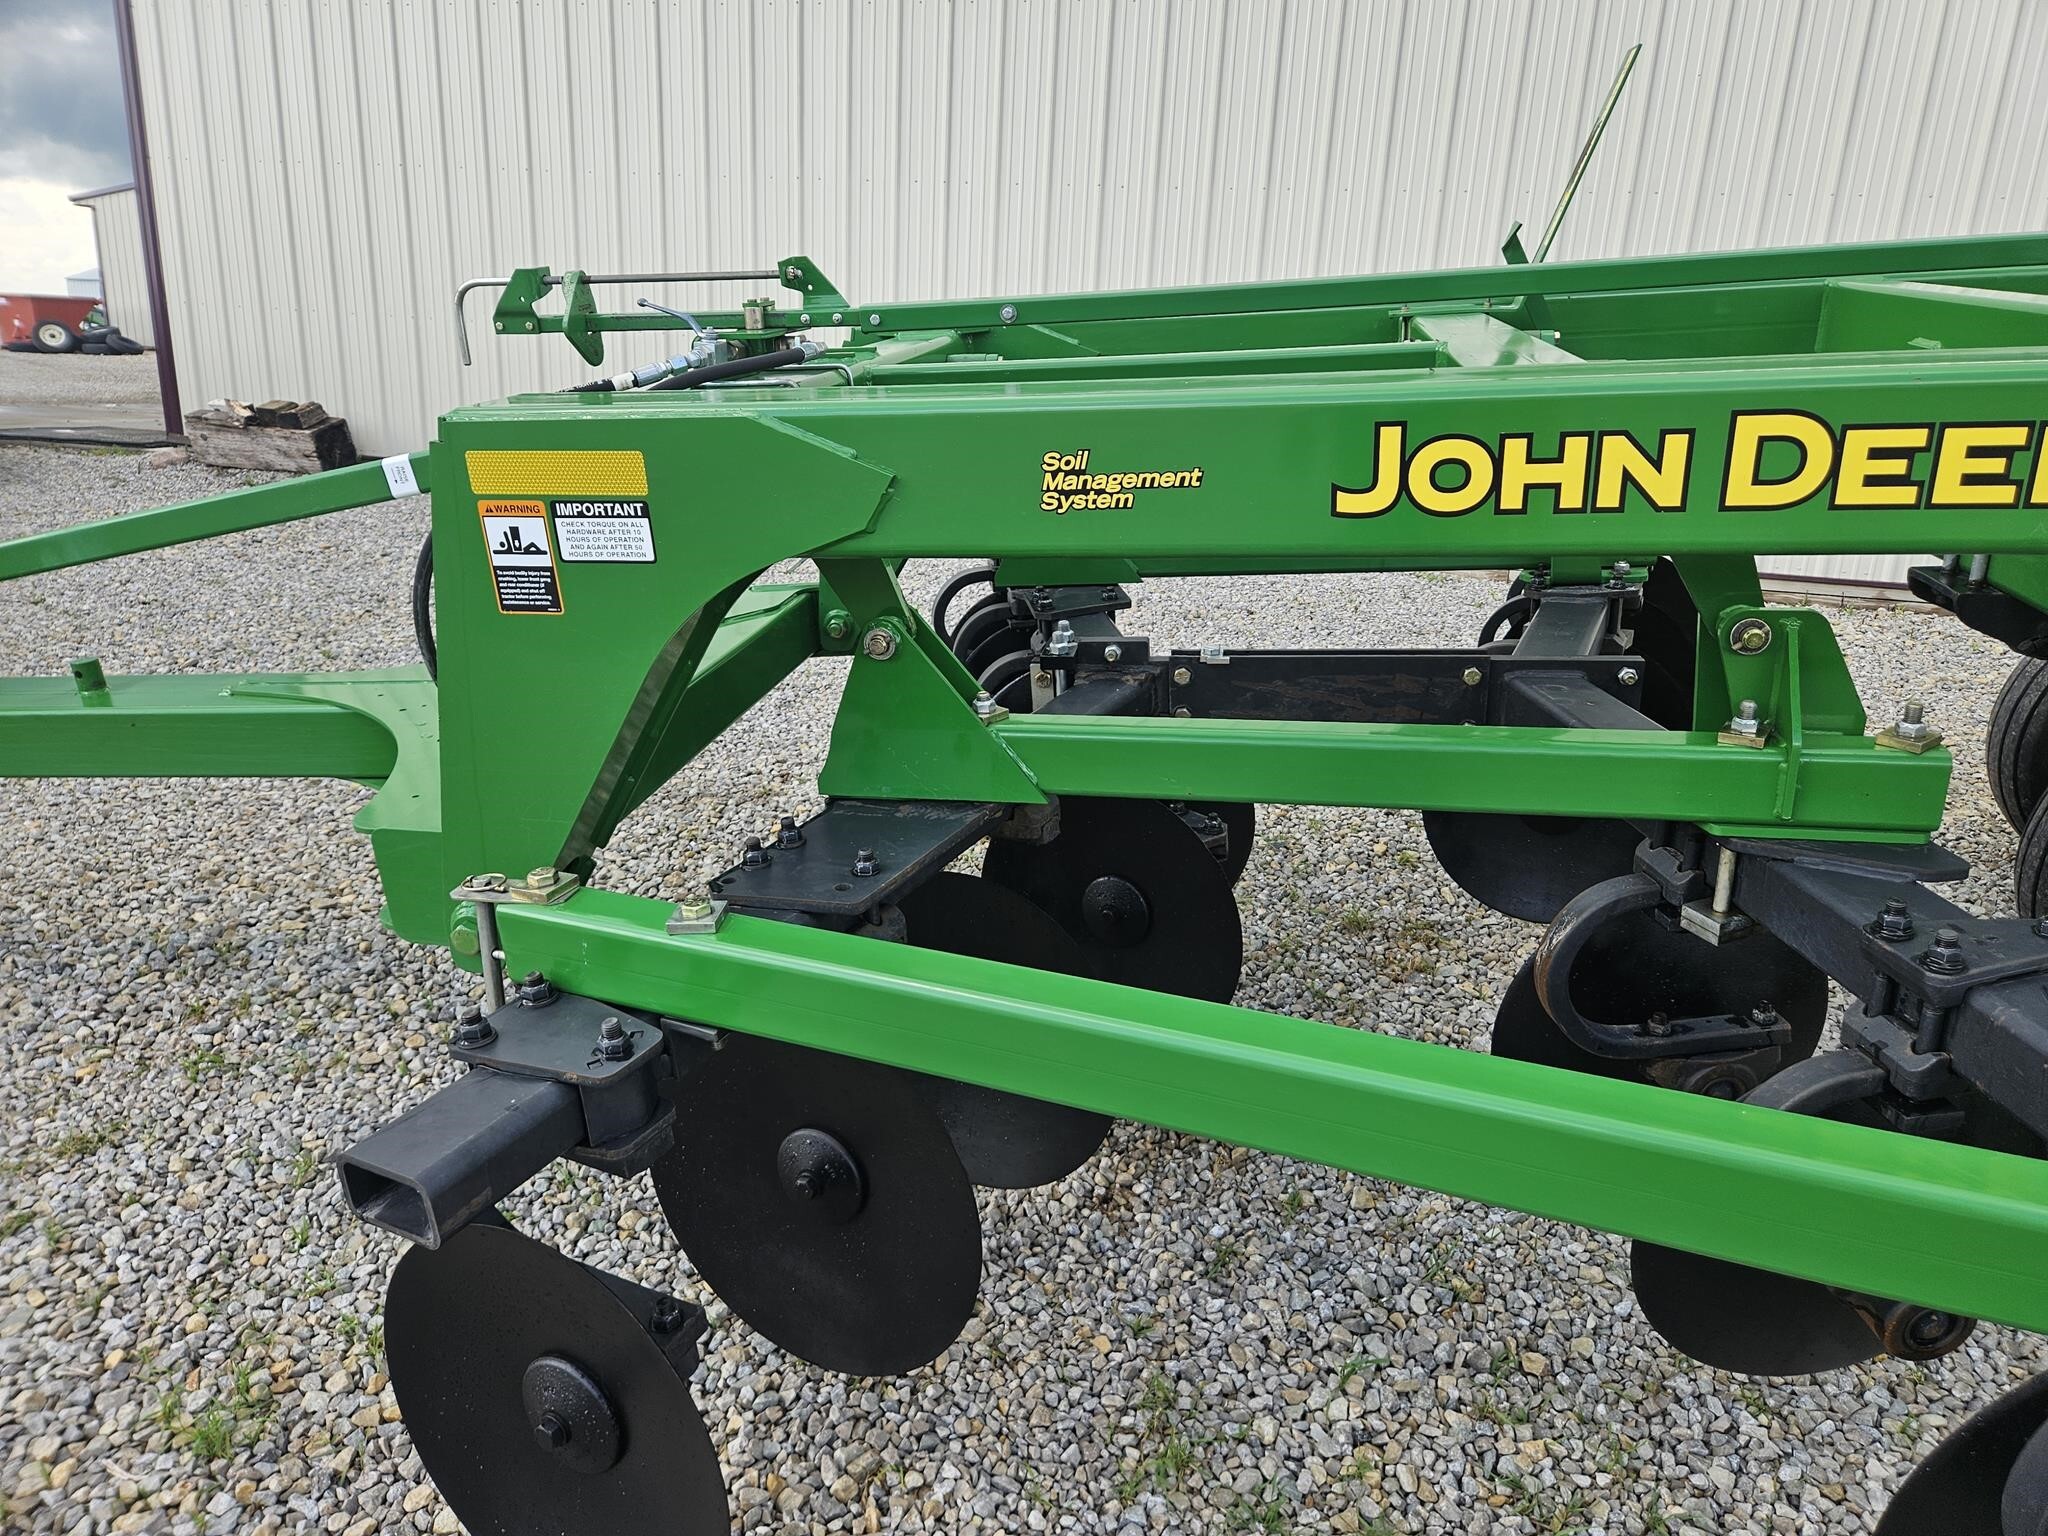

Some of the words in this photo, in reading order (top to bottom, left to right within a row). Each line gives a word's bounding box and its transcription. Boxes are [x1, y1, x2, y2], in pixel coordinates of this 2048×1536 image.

[1041, 449, 1090, 472] Soil
[1331, 421, 1696, 519] JOHN
[1718, 409, 2048, 513] DEE
[1041, 467, 1203, 493] Management
[493, 505, 540, 513] WARNING
[556, 503, 643, 516] IMPORTANT
[1041, 491, 1135, 515] System
